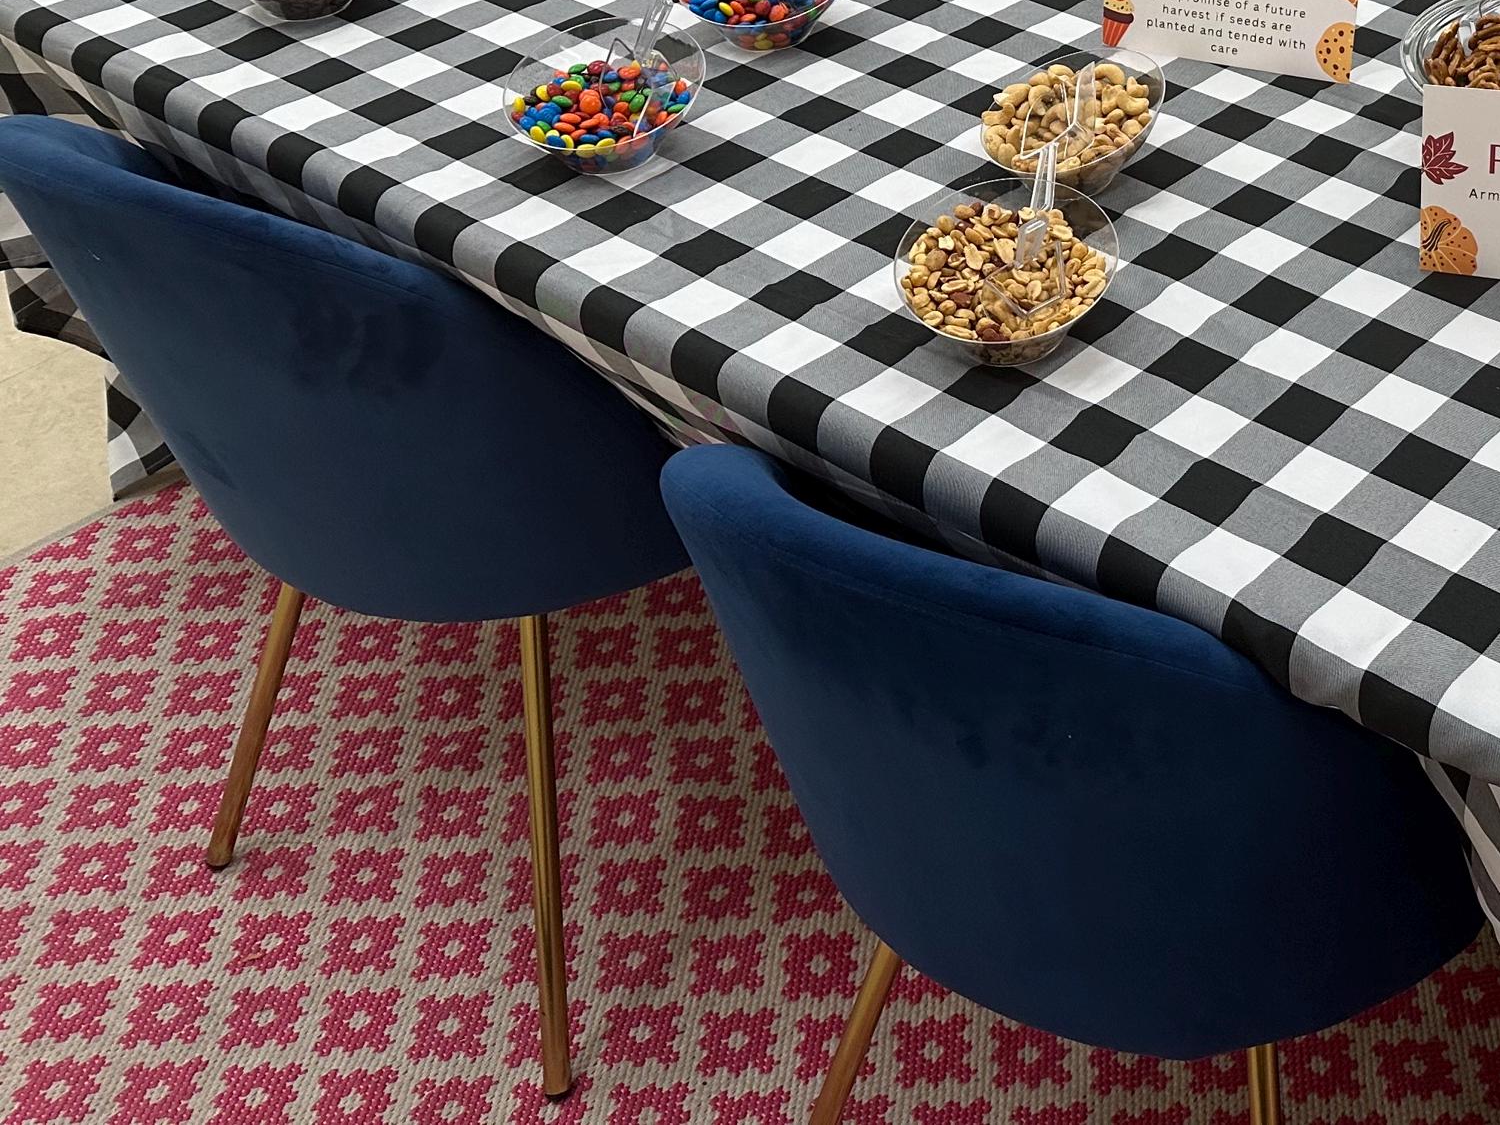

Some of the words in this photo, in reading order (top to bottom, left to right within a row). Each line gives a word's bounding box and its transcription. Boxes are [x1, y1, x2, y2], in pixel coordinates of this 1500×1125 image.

[1162, 4, 1211, 21] harvest
[1215, 12, 1225, 22] if
[1229, 14, 1266, 29] seeds
[1271, 21, 1292, 32] are
[1235, 0, 1248, 10] of
[1253, 3, 1260, 12] a
[1265, 3, 1306, 19] future
[1146, 17, 1195, 34] planted
[1200, 23, 1223, 37] and
[1228, 29, 1273, 45] tended
[1278, 38, 1306, 50] with
[1211, 43, 1239, 56] care
